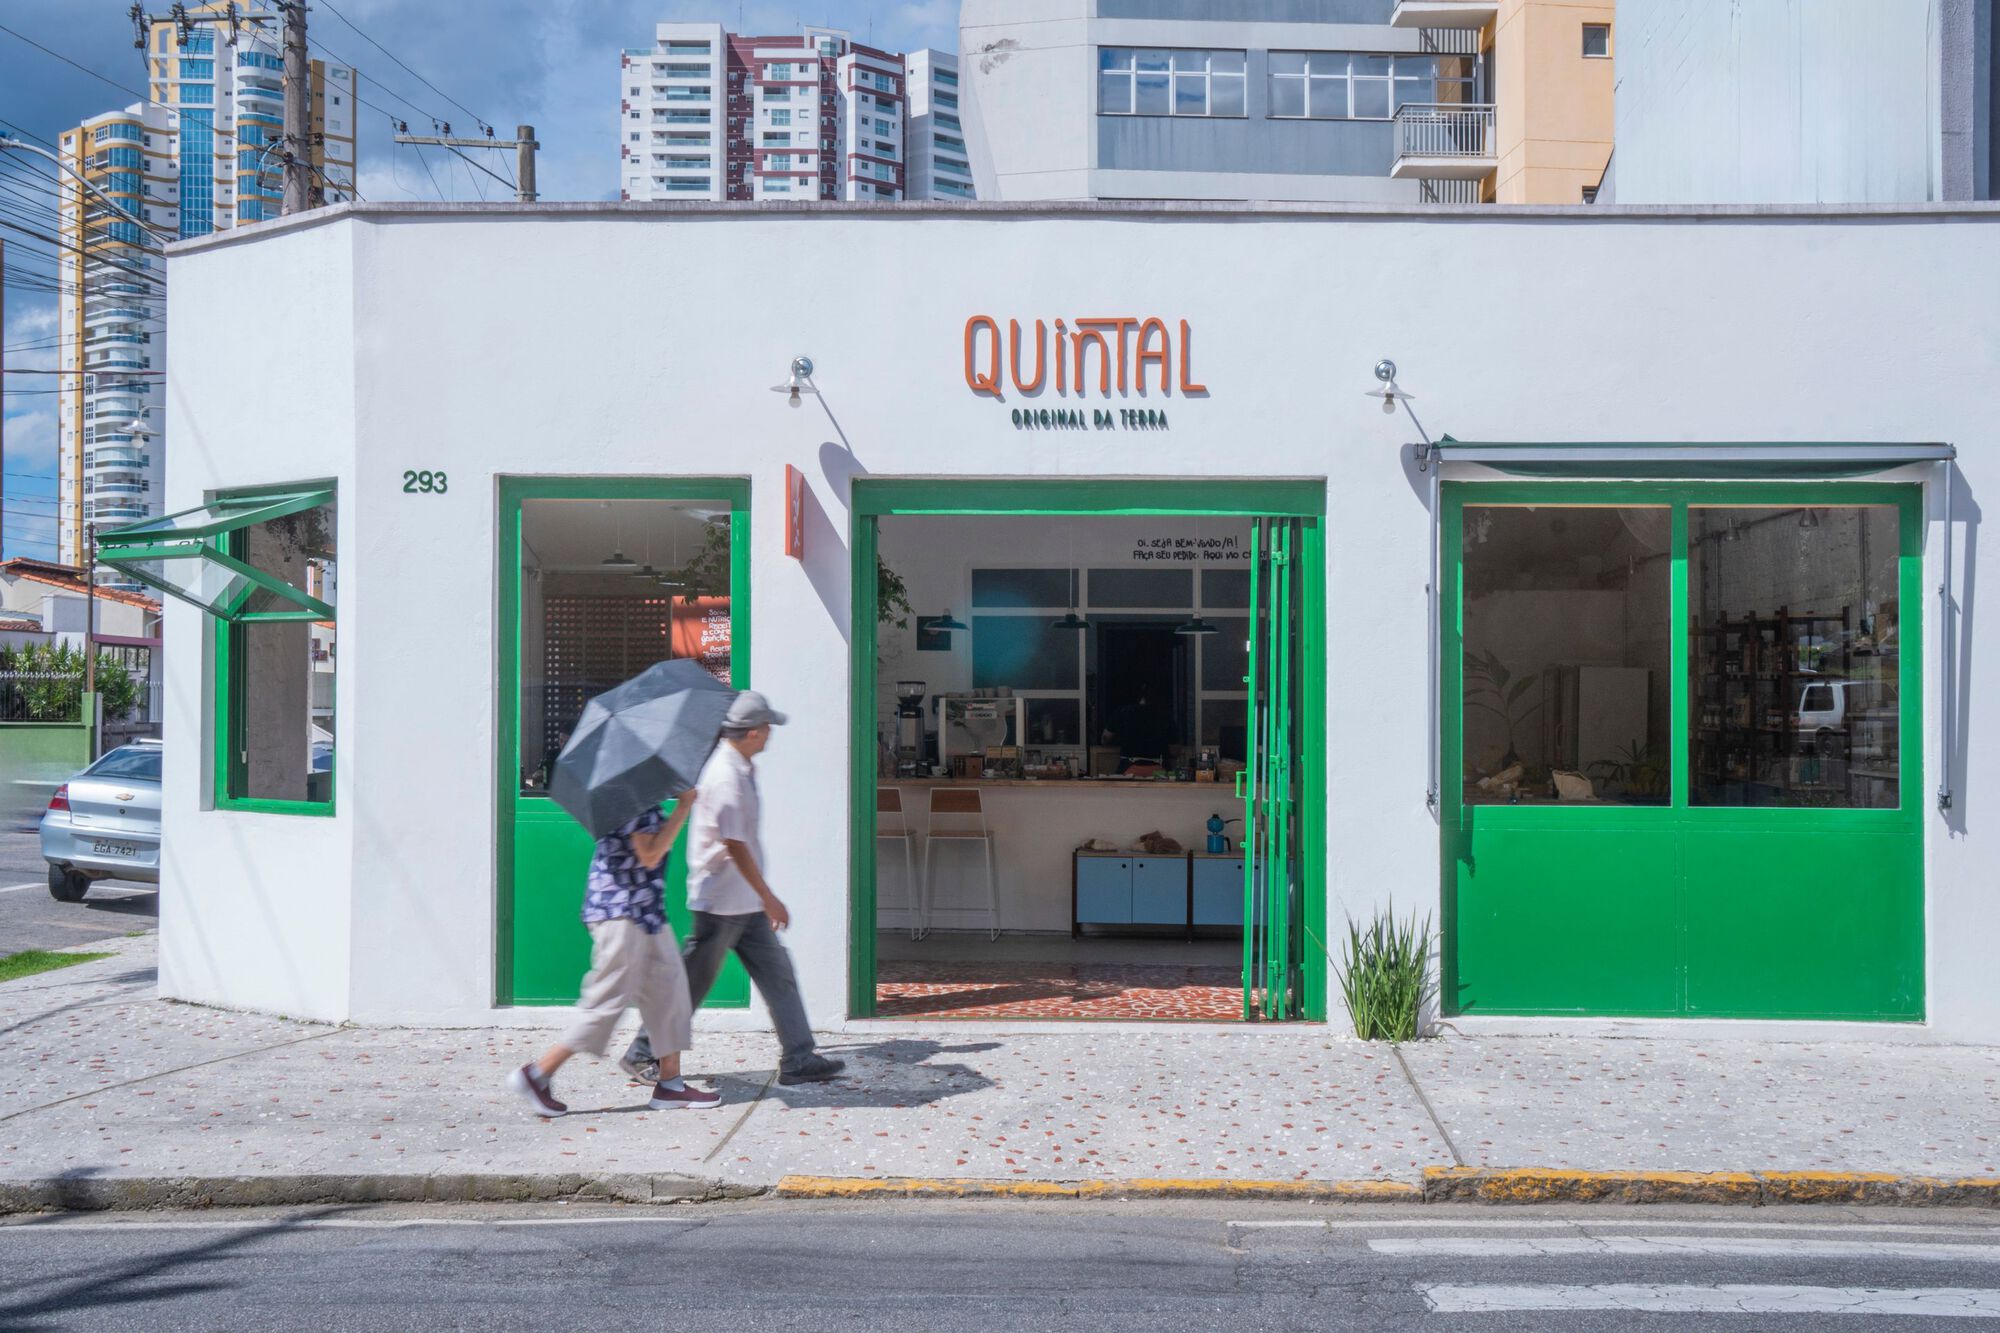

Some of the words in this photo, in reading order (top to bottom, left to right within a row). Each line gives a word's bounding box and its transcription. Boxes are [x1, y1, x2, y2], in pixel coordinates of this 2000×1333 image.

[1012, 408, 1086, 427] ORIGINAL
[1094, 408, 1113, 427] DA
[1120, 408, 1168, 427] TERRA
[403, 469, 448, 494] 293
[1156, 550, 1171, 560] SEU
[94, 843, 136, 857] EGA-7421
